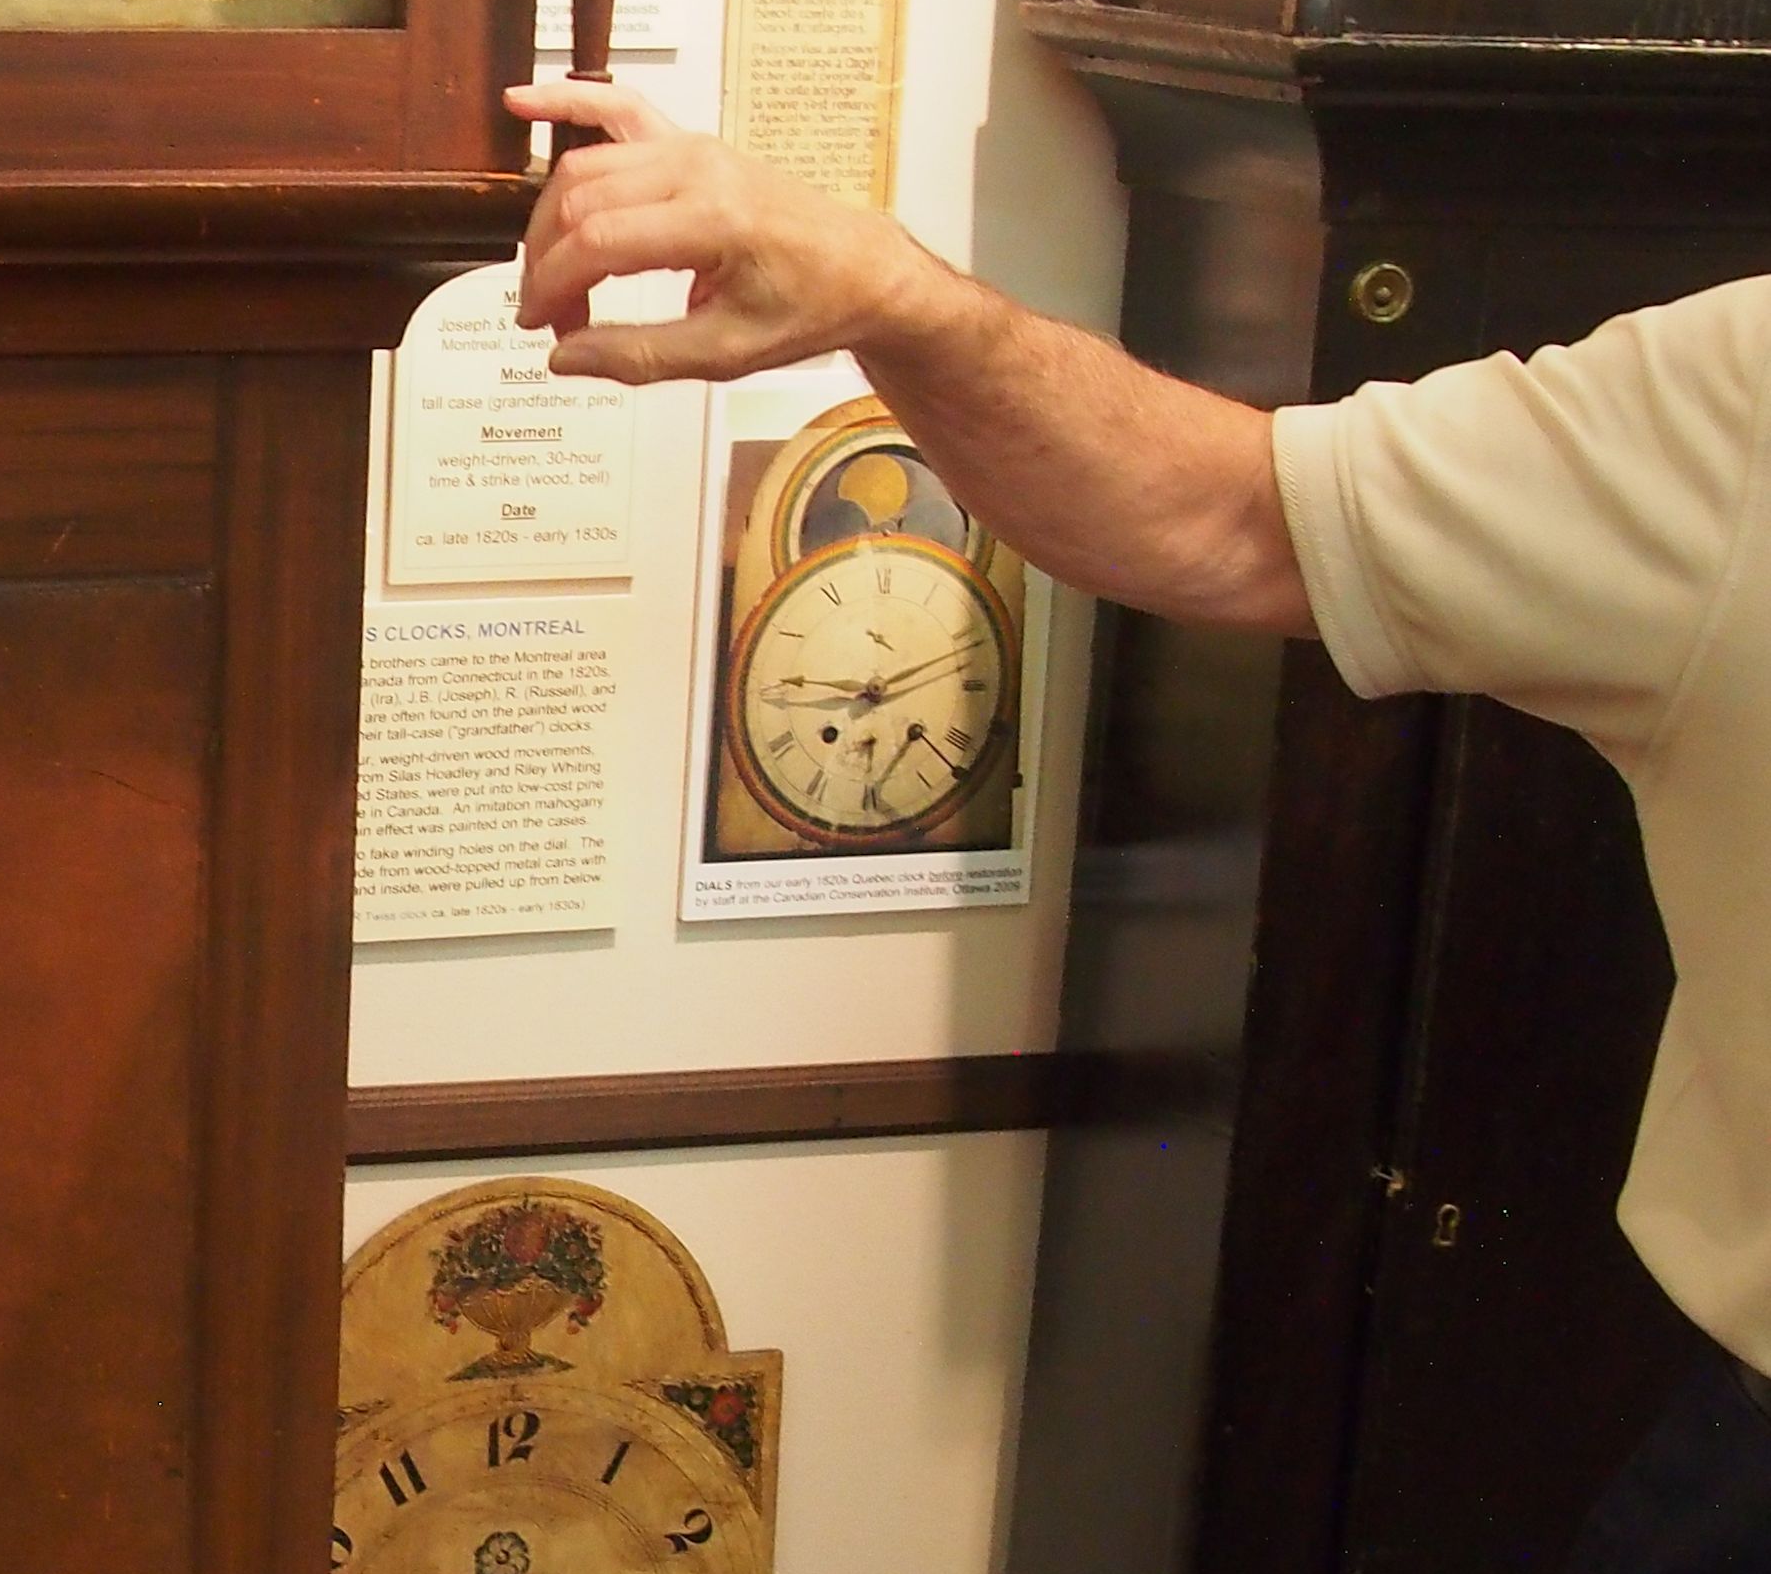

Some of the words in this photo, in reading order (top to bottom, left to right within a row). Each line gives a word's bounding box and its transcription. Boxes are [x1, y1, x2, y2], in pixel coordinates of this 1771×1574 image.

[437, 318, 492, 332] Joseph
[497, 317, 507, 331] &
[502, 367, 548, 382] Model
[422, 396, 443, 409] tall
[447, 398, 483, 409] case
[481, 426, 563, 440] Movement
[437, 454, 540, 469] weight-driven,
[546, 450, 603, 464] 30-hour
[429, 475, 461, 487] time
[465, 472, 476, 487] &
[481, 473, 521, 486] strike
[502, 503, 537, 518] Date
[443, 532, 469, 544] late
[476, 529, 519, 543] 1820s
[533, 529, 569, 544] early
[575, 526, 618, 540] 1830s
[385, 624, 470, 640] CLOCKS,
[478, 620, 585, 636] MONTREAL
[370, 657, 426, 669] brothers
[431, 656, 468, 666] came
[472, 654, 485, 665] to
[489, 653, 510, 664] the
[514, 650, 573, 662] Montreal
[577, 650, 607, 660] area
[408, 674, 438, 685] from
[442, 670, 522, 684] Connecticut
[526, 670, 538, 679] in
[542, 668, 564, 679] the
[695, 879, 733, 893] DIALS
[488, 1410, 541, 1467] 12
[601, 1441, 631, 1485] 1
[379, 1448, 427, 1507] 11
[663, 1507, 713, 1553] 2
